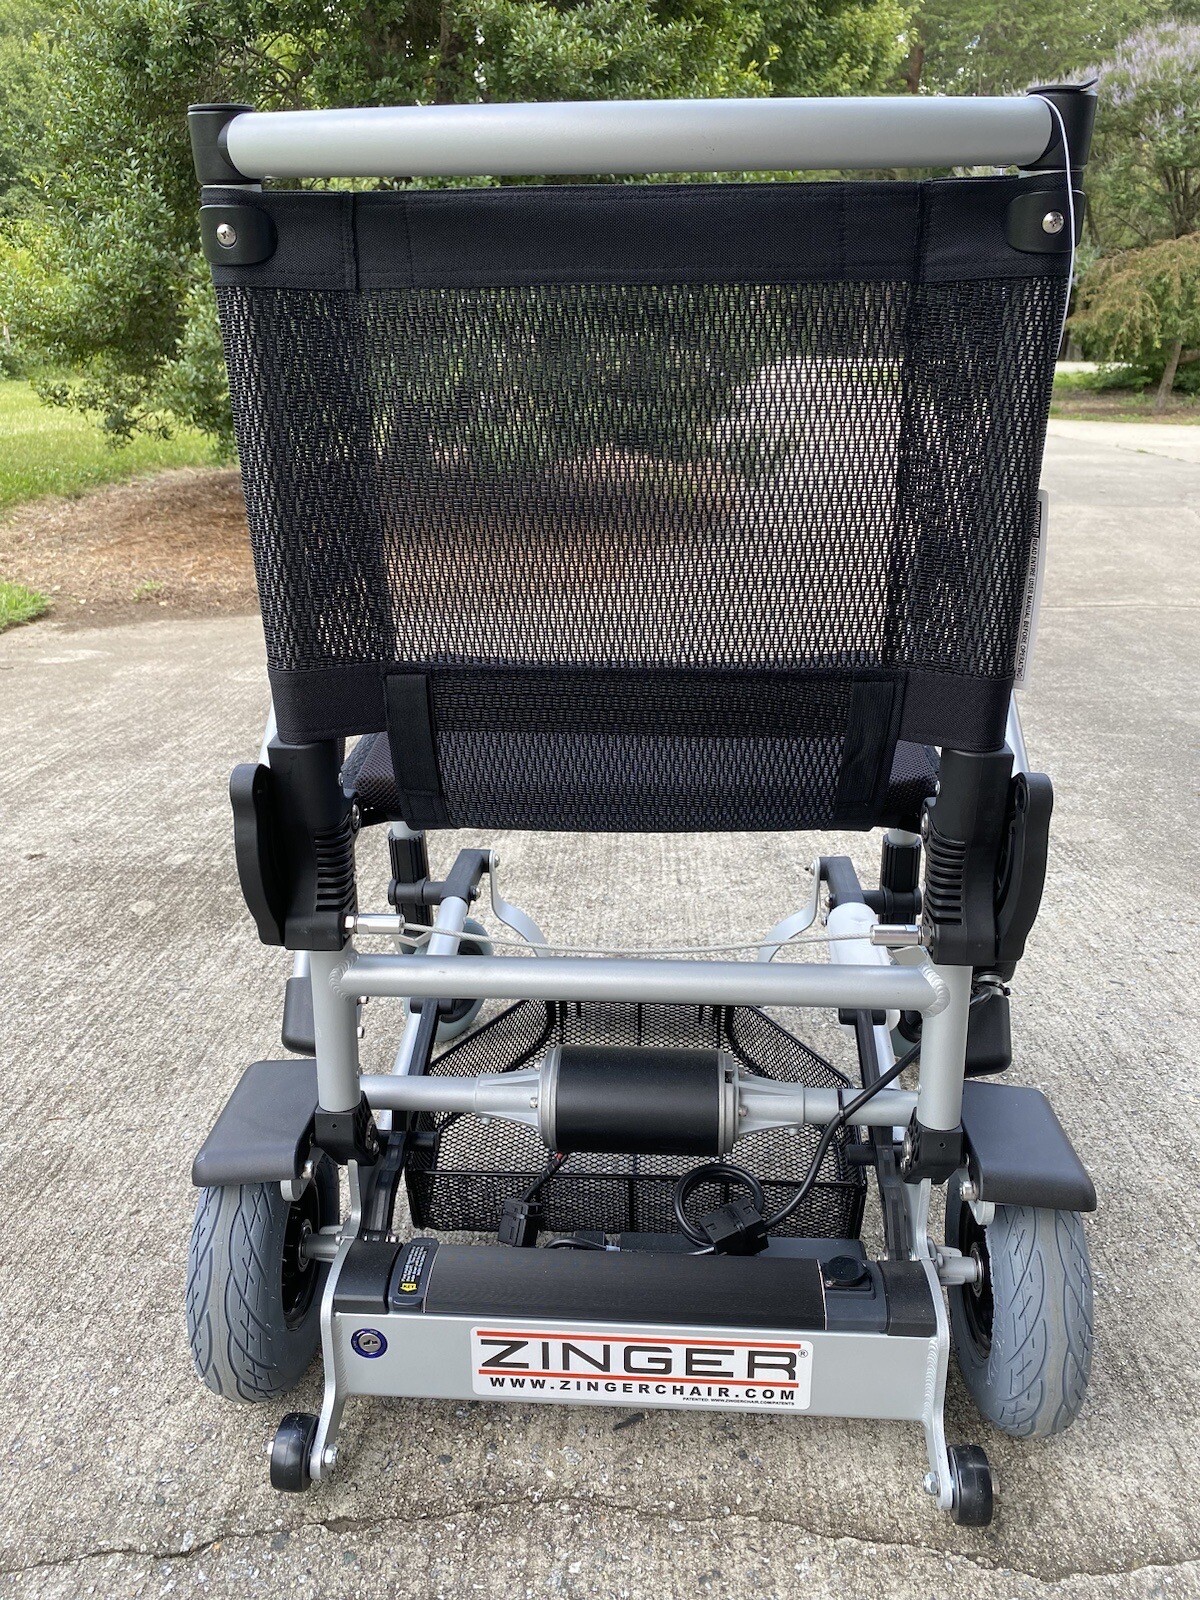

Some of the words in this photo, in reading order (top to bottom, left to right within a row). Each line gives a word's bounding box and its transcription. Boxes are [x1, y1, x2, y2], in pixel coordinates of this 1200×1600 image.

[1029, 556, 1037, 577] ENTIRE
[1027, 578, 1035, 595] USER
[1024, 595, 1033, 619] MANUAL
[489, 1376, 796, 1401] WWW.ZINGERCHAIR.COM
